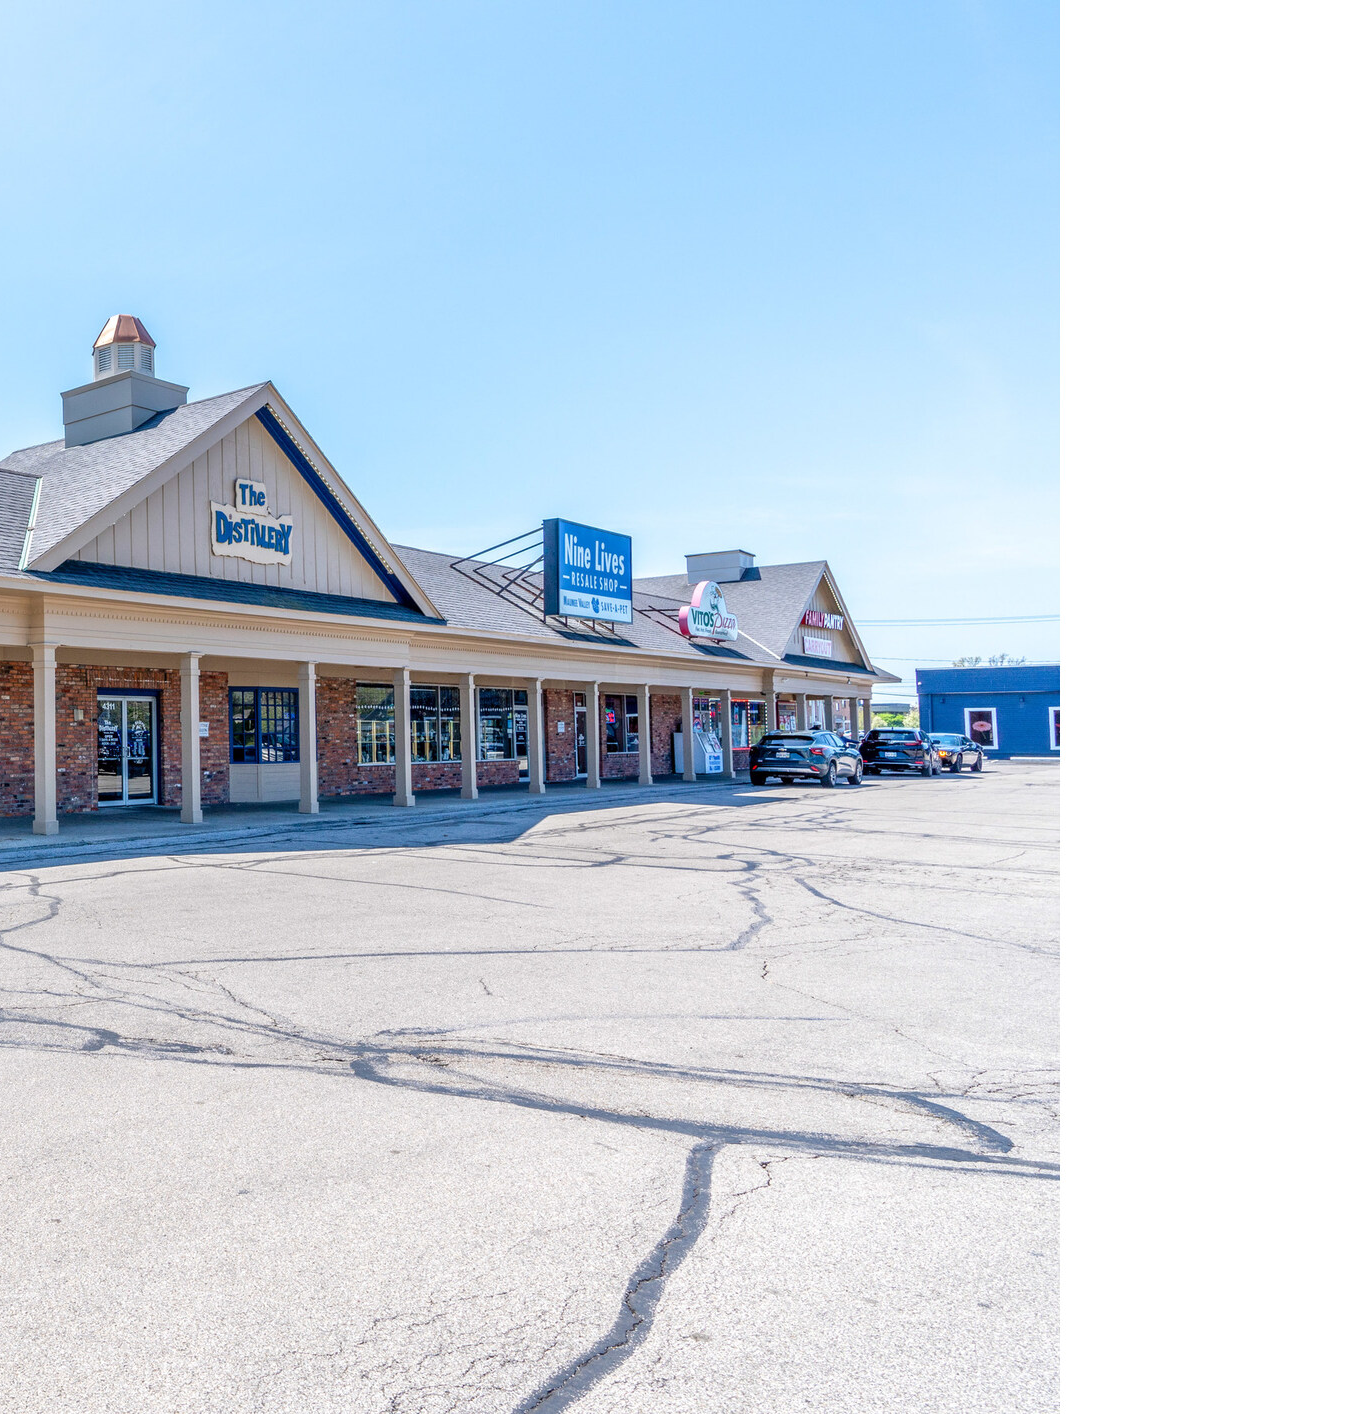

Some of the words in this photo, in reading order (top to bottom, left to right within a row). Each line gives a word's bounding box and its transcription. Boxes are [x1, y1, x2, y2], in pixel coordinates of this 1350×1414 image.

[239, 483, 266, 507] The
[564, 533, 591, 569] Nine
[595, 540, 625, 576] Lives
[571, 571, 598, 590] RESALE
[599, 576, 619, 593] SHOP
[691, 608, 714, 628] VITO'S
[805, 609, 825, 628] FAMILY
[824, 613, 844, 631] PANTRY
[102, 701, 116, 710] 4311
